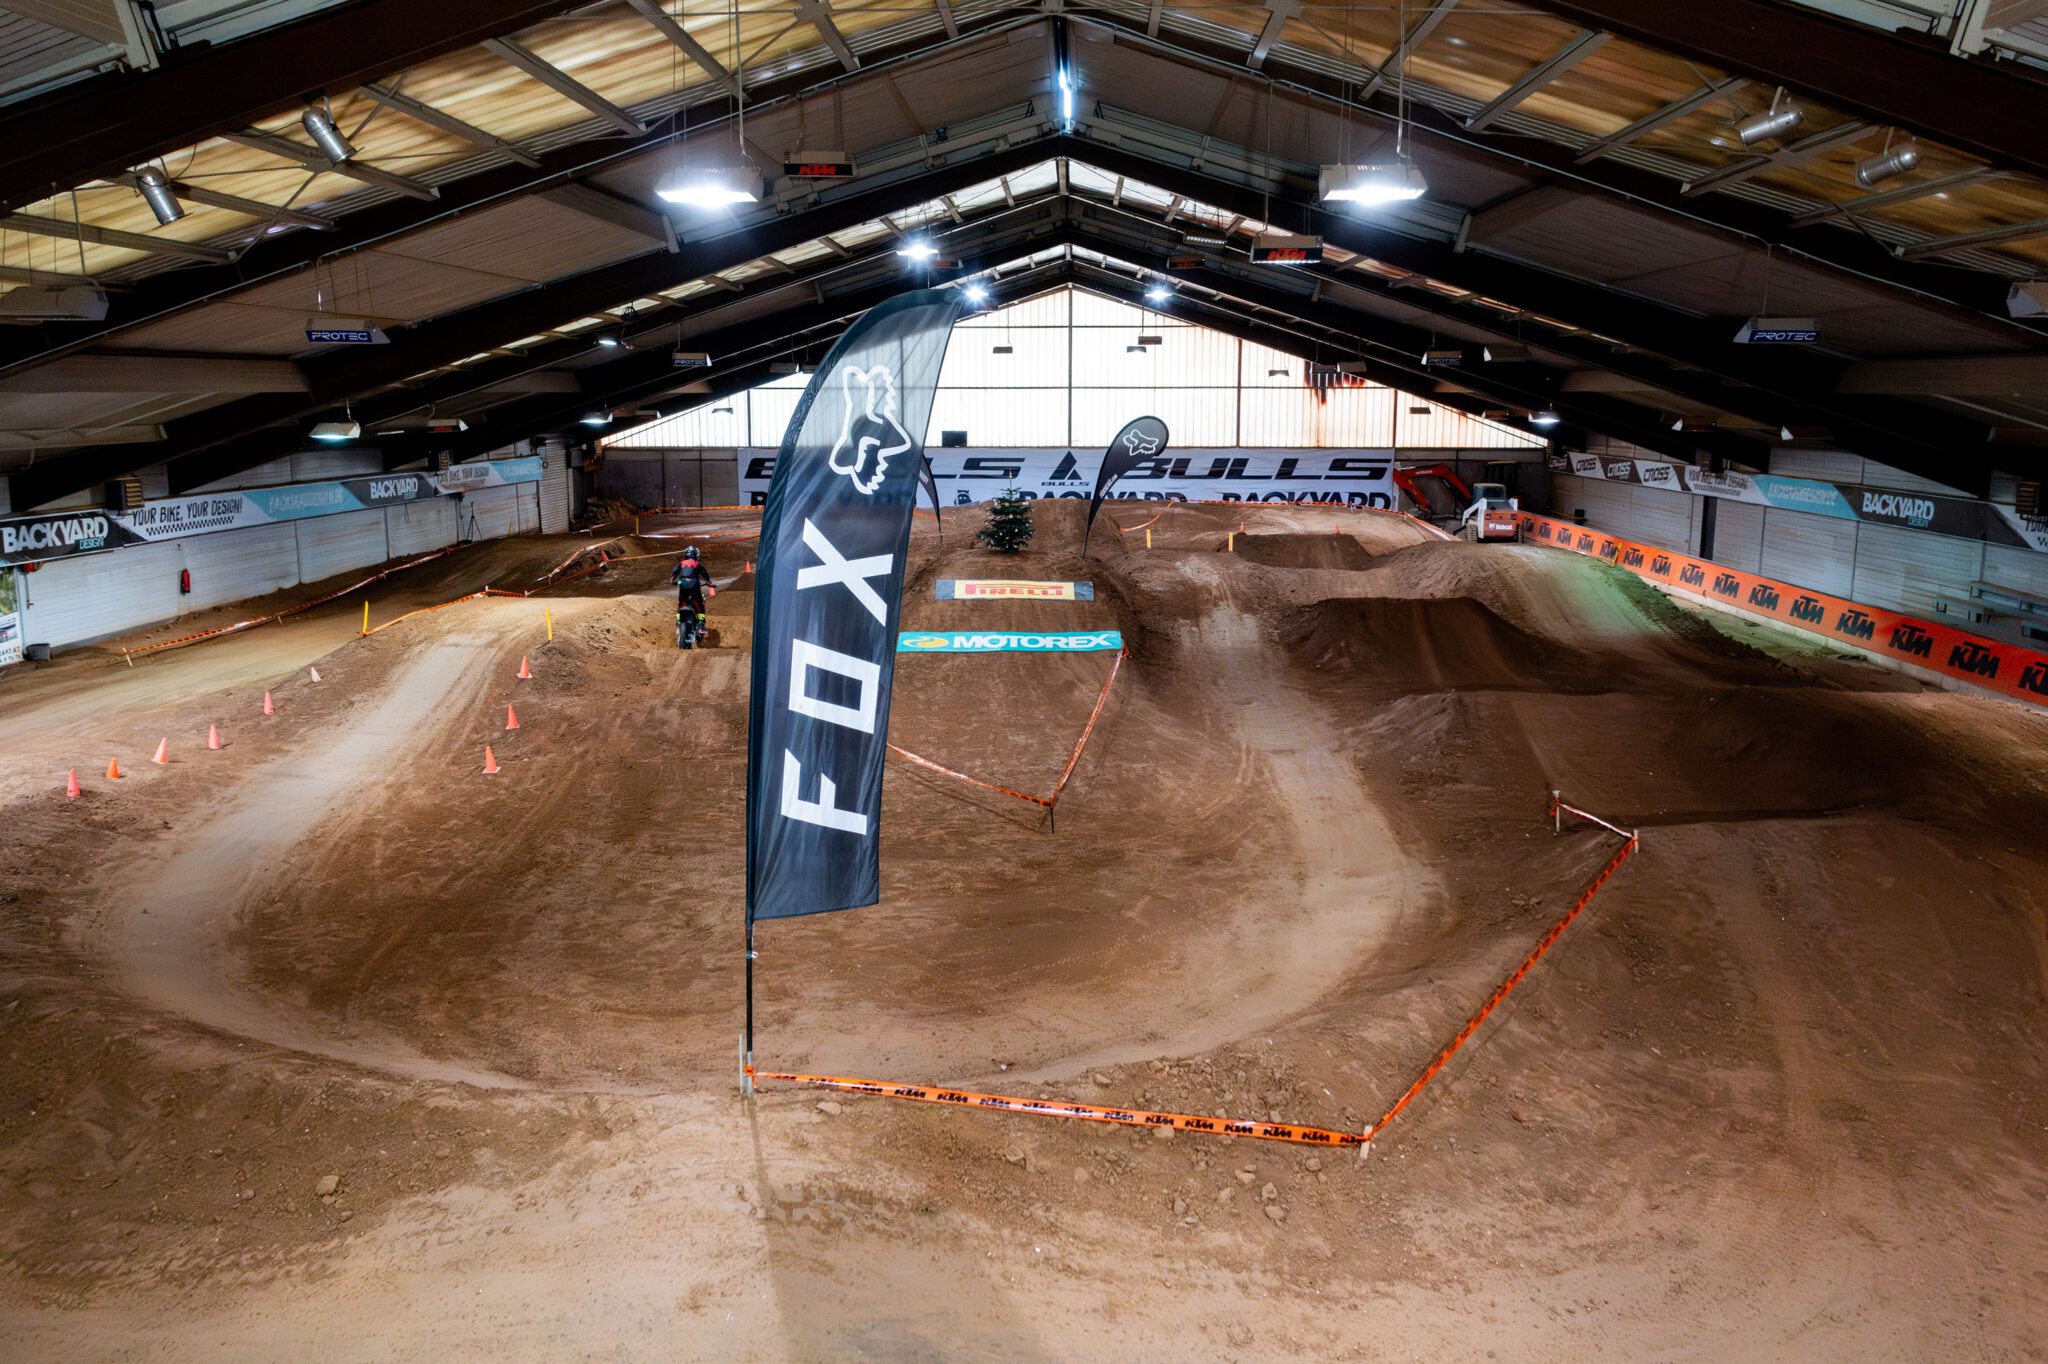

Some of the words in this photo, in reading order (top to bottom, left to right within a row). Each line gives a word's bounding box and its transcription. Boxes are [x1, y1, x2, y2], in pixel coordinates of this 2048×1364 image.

[799, 164, 837, 175] KTM
[1266, 248, 1307, 260] KTM
[311, 332, 368, 341] PROTEC
[1754, 332, 1816, 341] PROTEC
[1118, 457, 1392, 480] BULLS
[1643, 465, 1670, 483] CROSS
[370, 478, 418, 499] BACKYARD
[132, 508, 156, 527] YOUR
[160, 506, 183, 523] BIKE,
[187, 501, 209, 519] YOUR
[211, 497, 243, 516] DESIGN!
[1862, 492, 1935, 521] BACKYARD
[1, 516, 109, 554] BACKYARD
[79, 537, 104, 550] DESIGN
[964, 583, 1064, 596] PIRELLI
[1557, 527, 1572, 546] KTM
[1577, 533, 1594, 552] KTM
[1623, 547, 1644, 568] KTM
[1650, 554, 1672, 576] KTM
[1679, 563, 1706, 587] KTM
[1712, 573, 1740, 598] KTM
[1749, 584, 1780, 611] KTM
[1790, 595, 1825, 625] KTM
[1835, 609, 1876, 641] KTM
[1888, 624, 1934, 658] KTM
[1947, 641, 2001, 679] KTM
[953, 633, 1118, 649] MOTOREX
[780, 517, 894, 836] FOX
[1301, 1130, 1330, 1142] KTM
